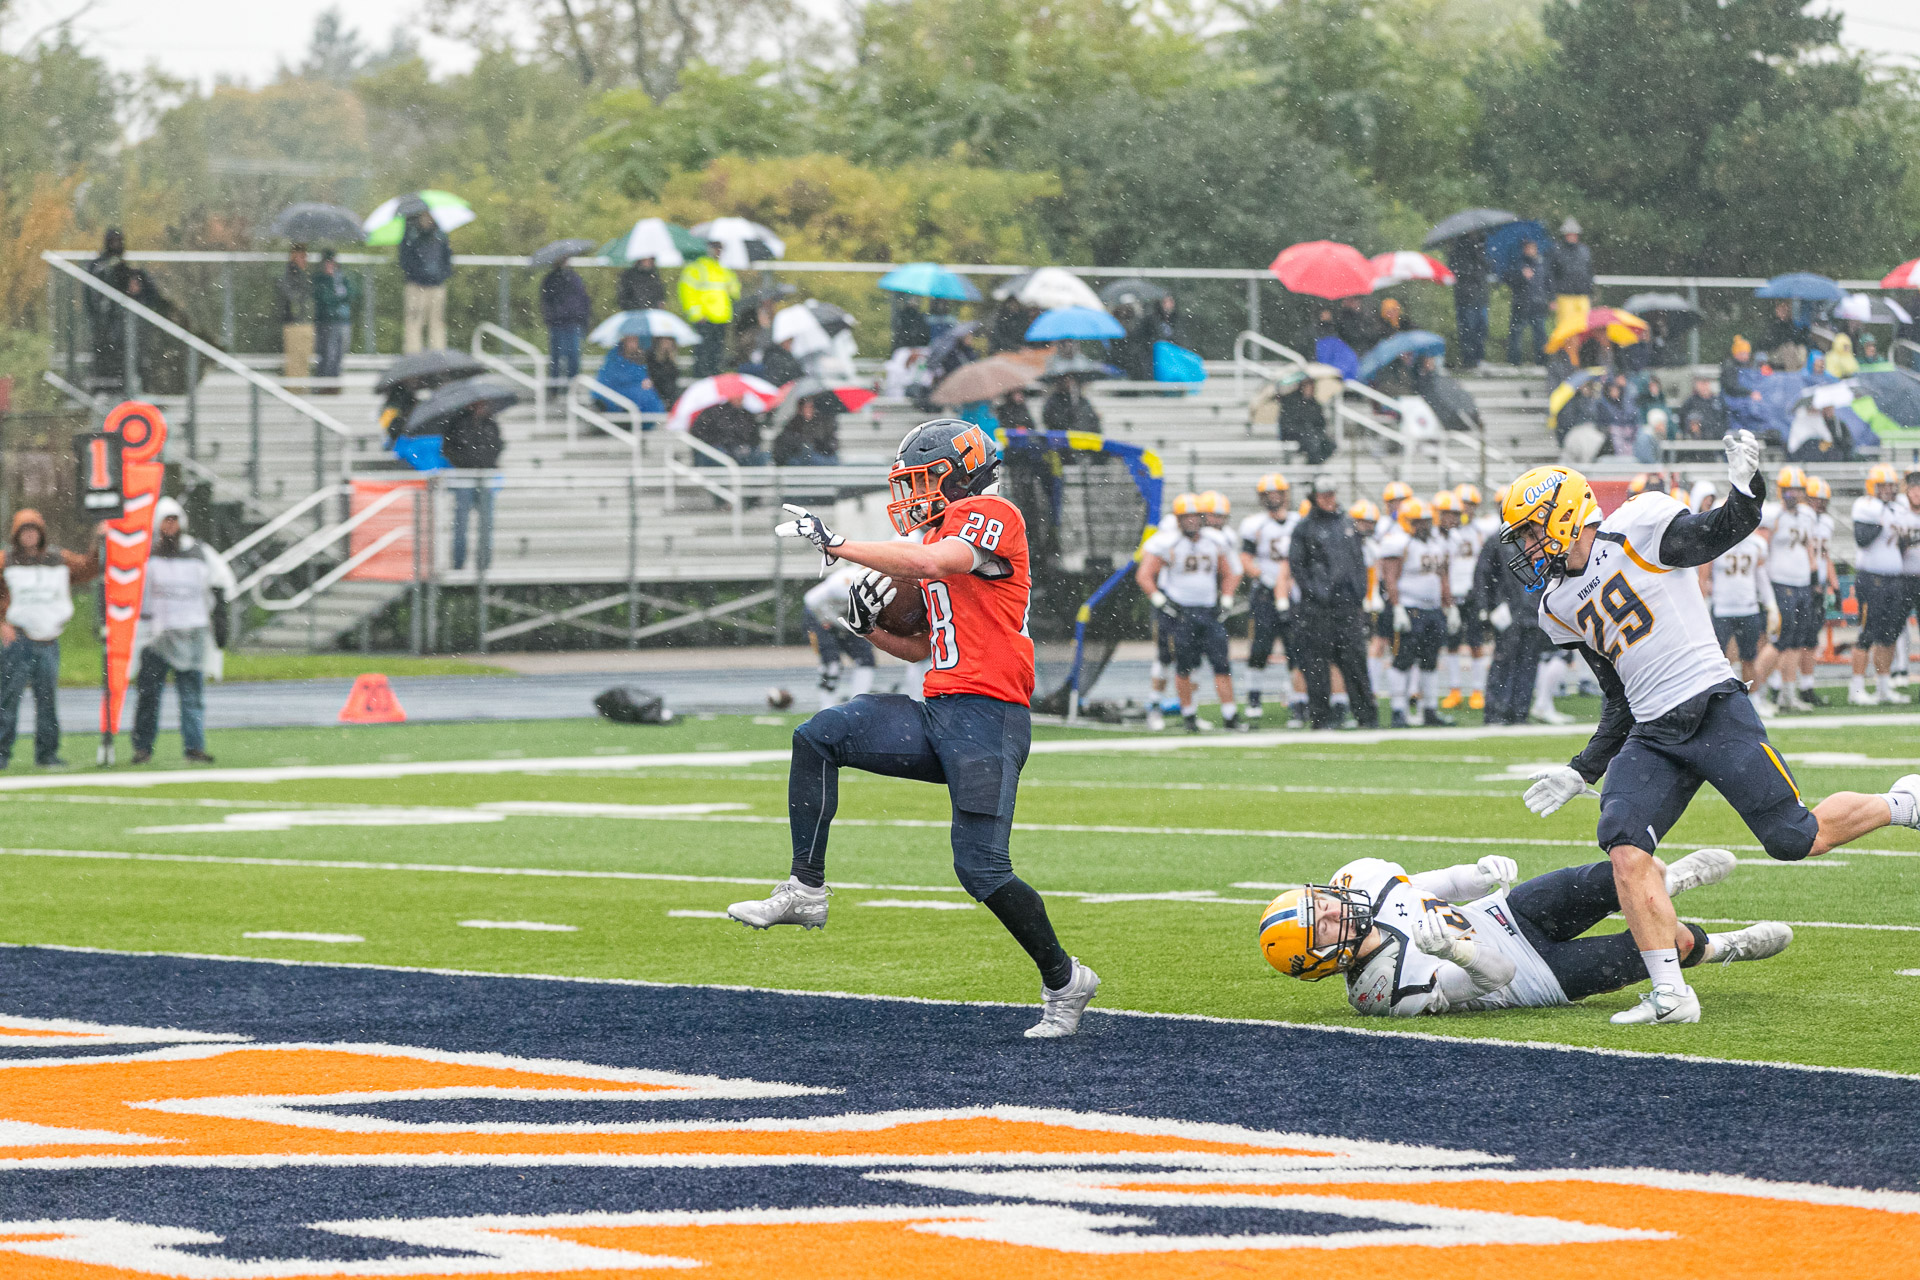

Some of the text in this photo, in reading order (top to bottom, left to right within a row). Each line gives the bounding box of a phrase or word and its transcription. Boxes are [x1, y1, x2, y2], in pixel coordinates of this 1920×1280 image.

[89, 438, 111, 489] 1
[958, 511, 1004, 552] 28
[1577, 576, 1601, 601] VIKINGS
[1576, 569, 1656, 664] 29
